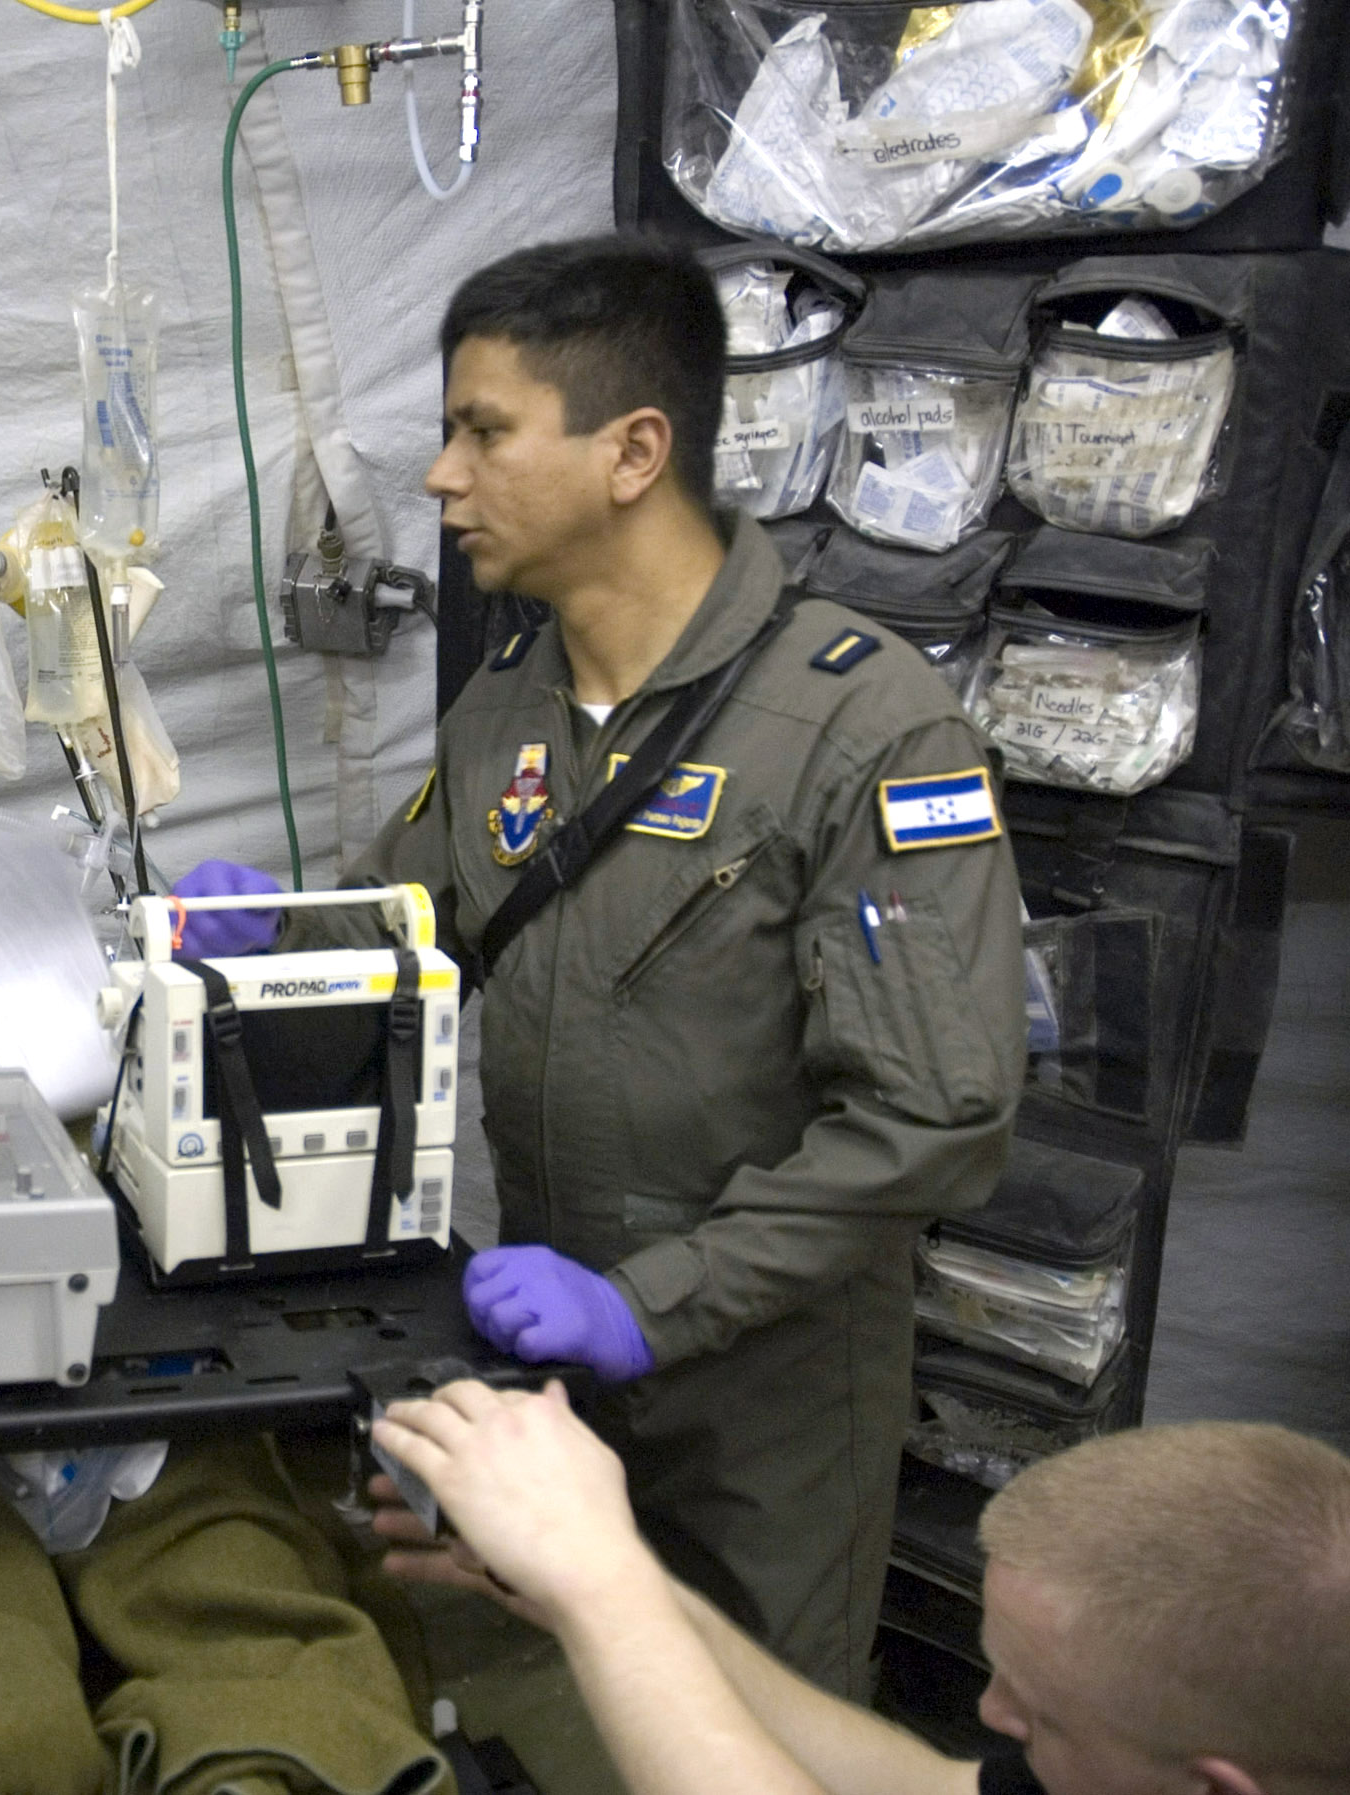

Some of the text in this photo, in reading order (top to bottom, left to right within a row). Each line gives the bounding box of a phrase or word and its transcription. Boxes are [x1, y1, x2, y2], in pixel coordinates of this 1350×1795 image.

[873, 132, 961, 163] electrodes
[861, 402, 953, 431] alcohol pads
[1035, 692, 1094, 716] Needles
